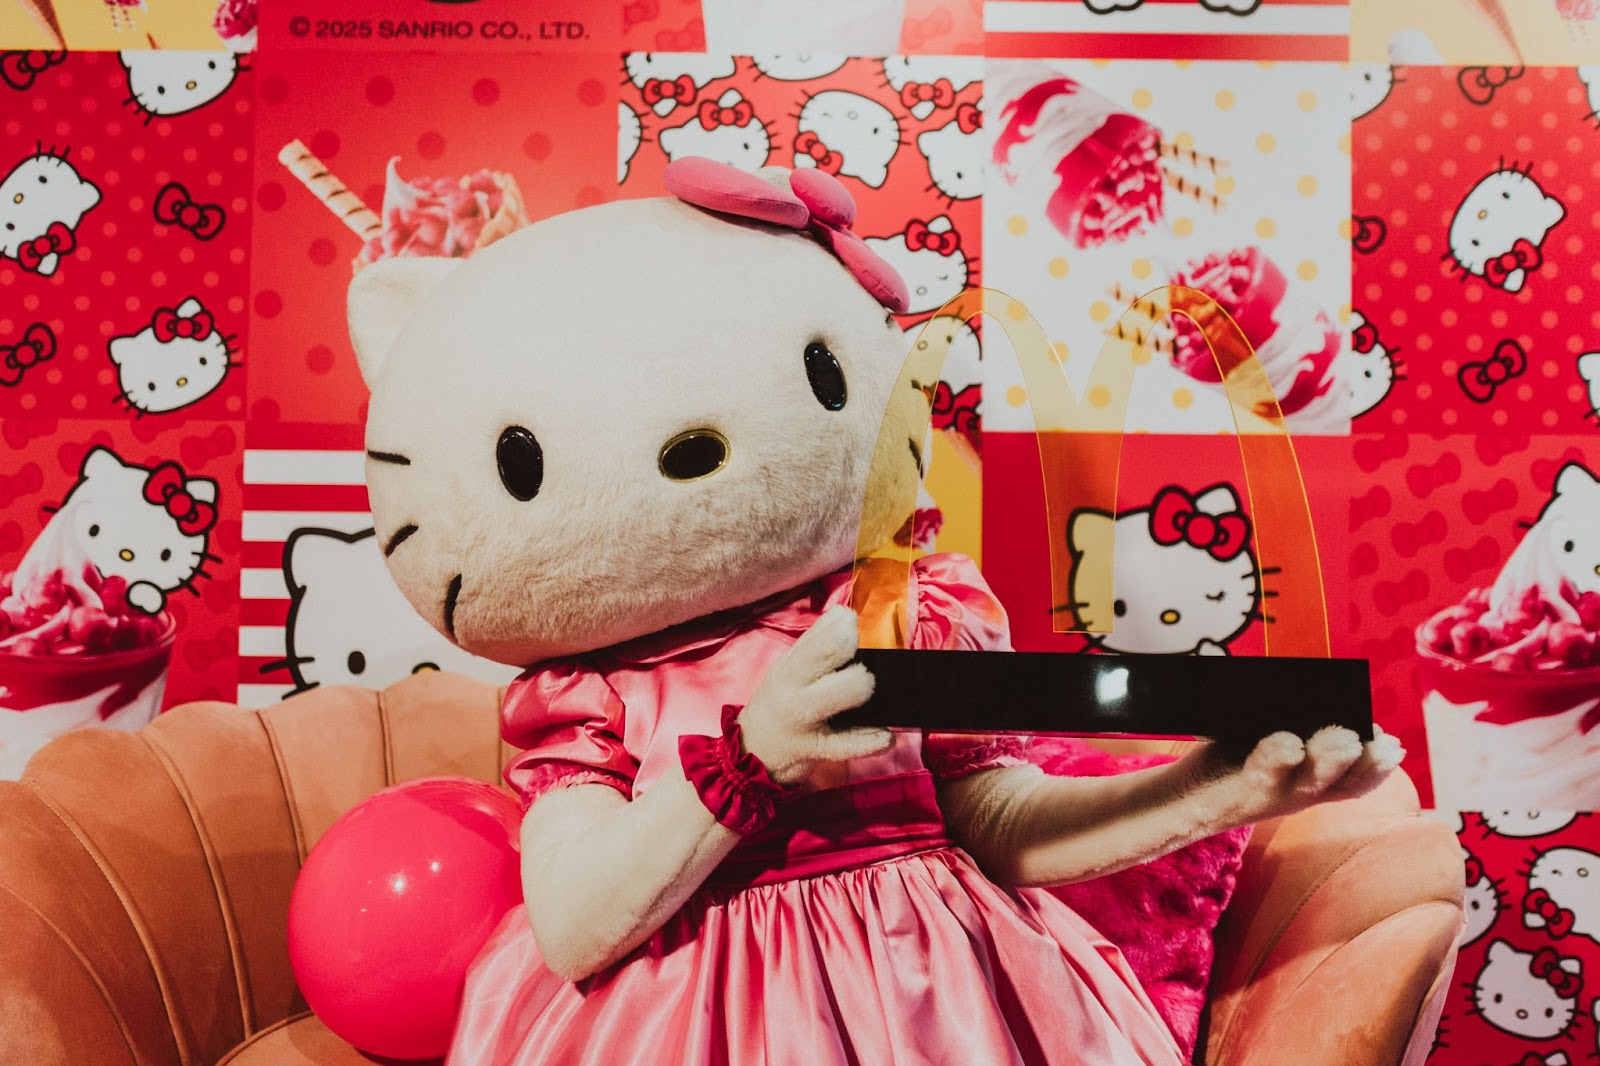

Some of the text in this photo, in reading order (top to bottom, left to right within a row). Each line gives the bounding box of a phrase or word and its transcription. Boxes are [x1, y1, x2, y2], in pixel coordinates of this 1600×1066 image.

[289, 16, 590, 40] © 2025 SANRIO CO., LTD.
